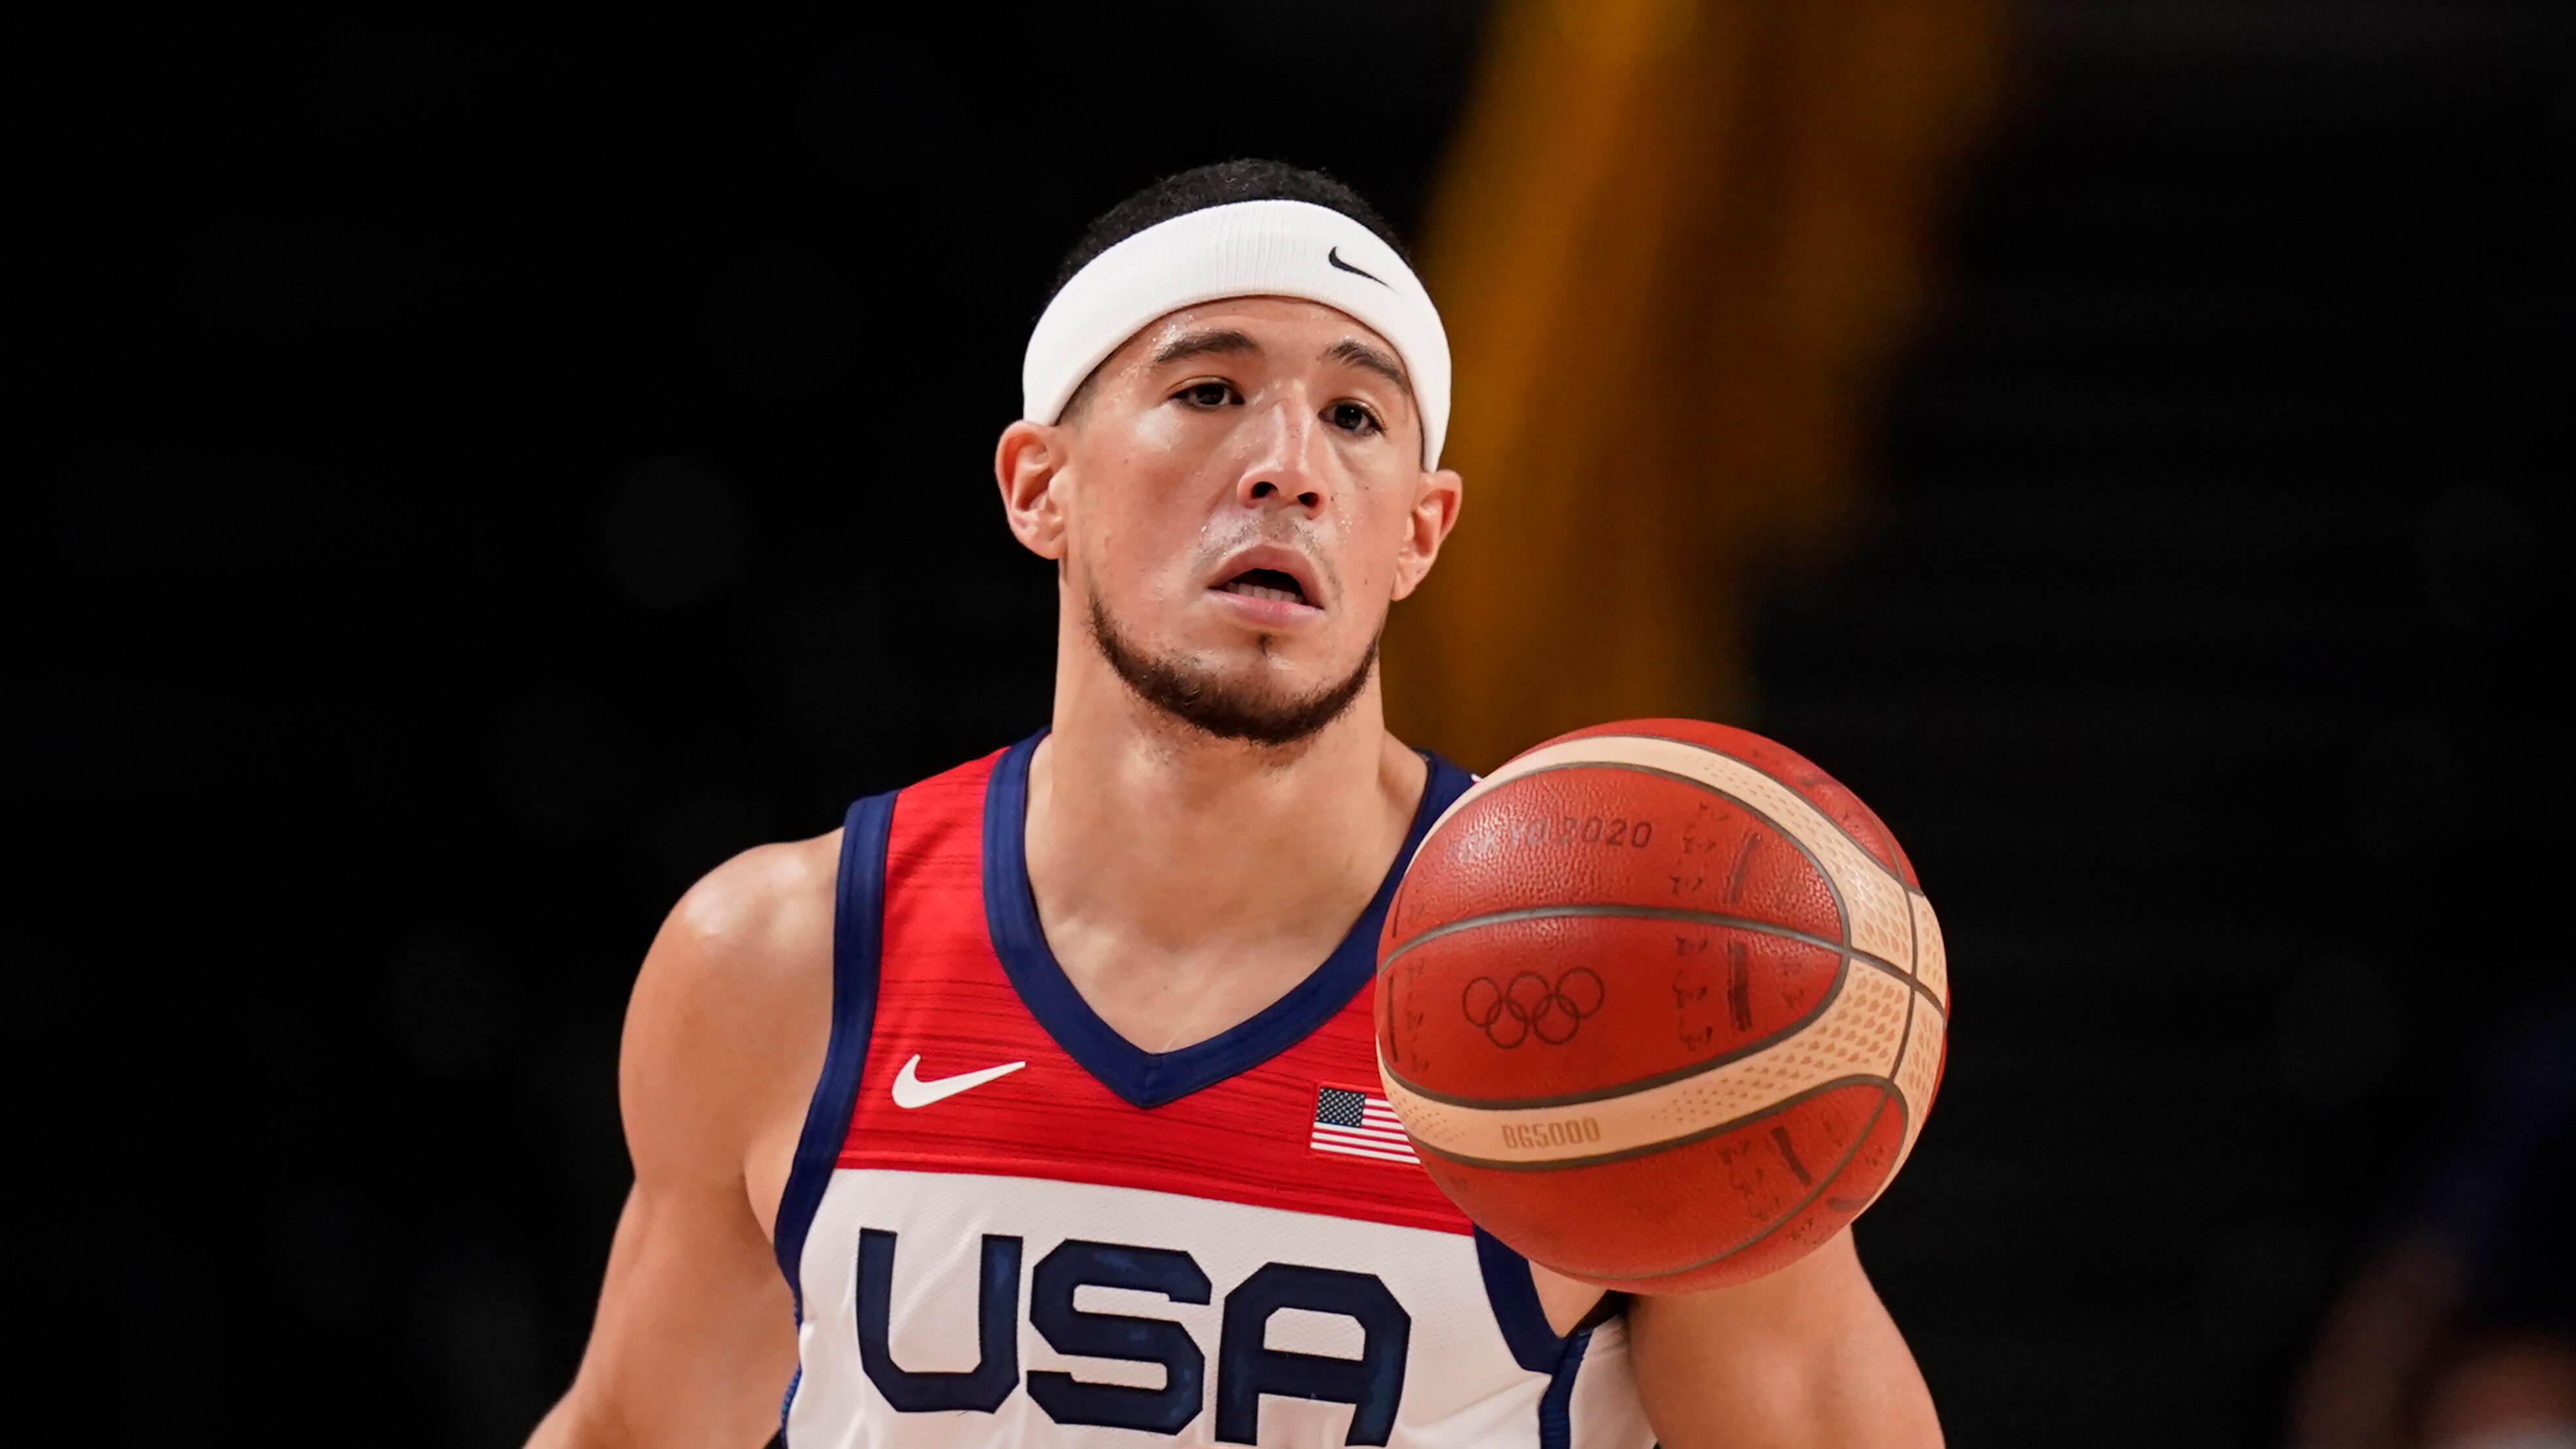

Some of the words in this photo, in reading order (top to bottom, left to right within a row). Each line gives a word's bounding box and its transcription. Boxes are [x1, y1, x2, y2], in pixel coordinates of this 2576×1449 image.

[1559, 818, 1652, 848] 2020
[1503, 1117, 1601, 1149] BG5000
[856, 1228, 1411, 1447] USA
